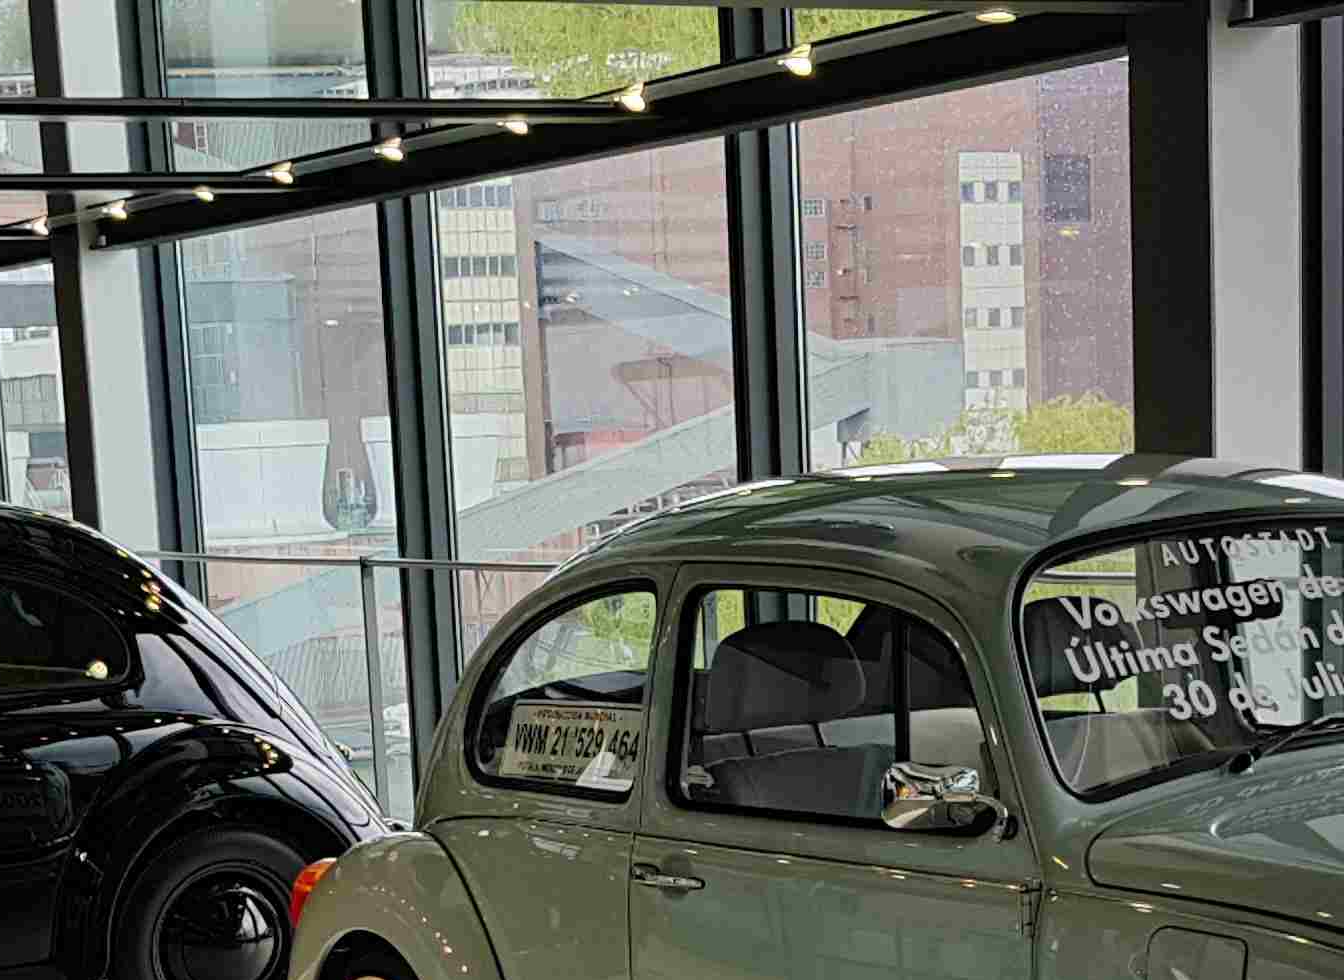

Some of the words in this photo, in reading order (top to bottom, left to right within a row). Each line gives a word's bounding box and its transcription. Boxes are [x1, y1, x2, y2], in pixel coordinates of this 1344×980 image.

[1161, 527, 1333, 568] AUTOSTADT
[1059, 579, 1285, 631] Volkswagen
[1298, 563, 1339, 602] de
[1064, 635, 1199, 683] Última
[1162, 679, 1218, 721] 30
[1228, 672, 1281, 714] de
[515, 723, 550, 755] VWM
